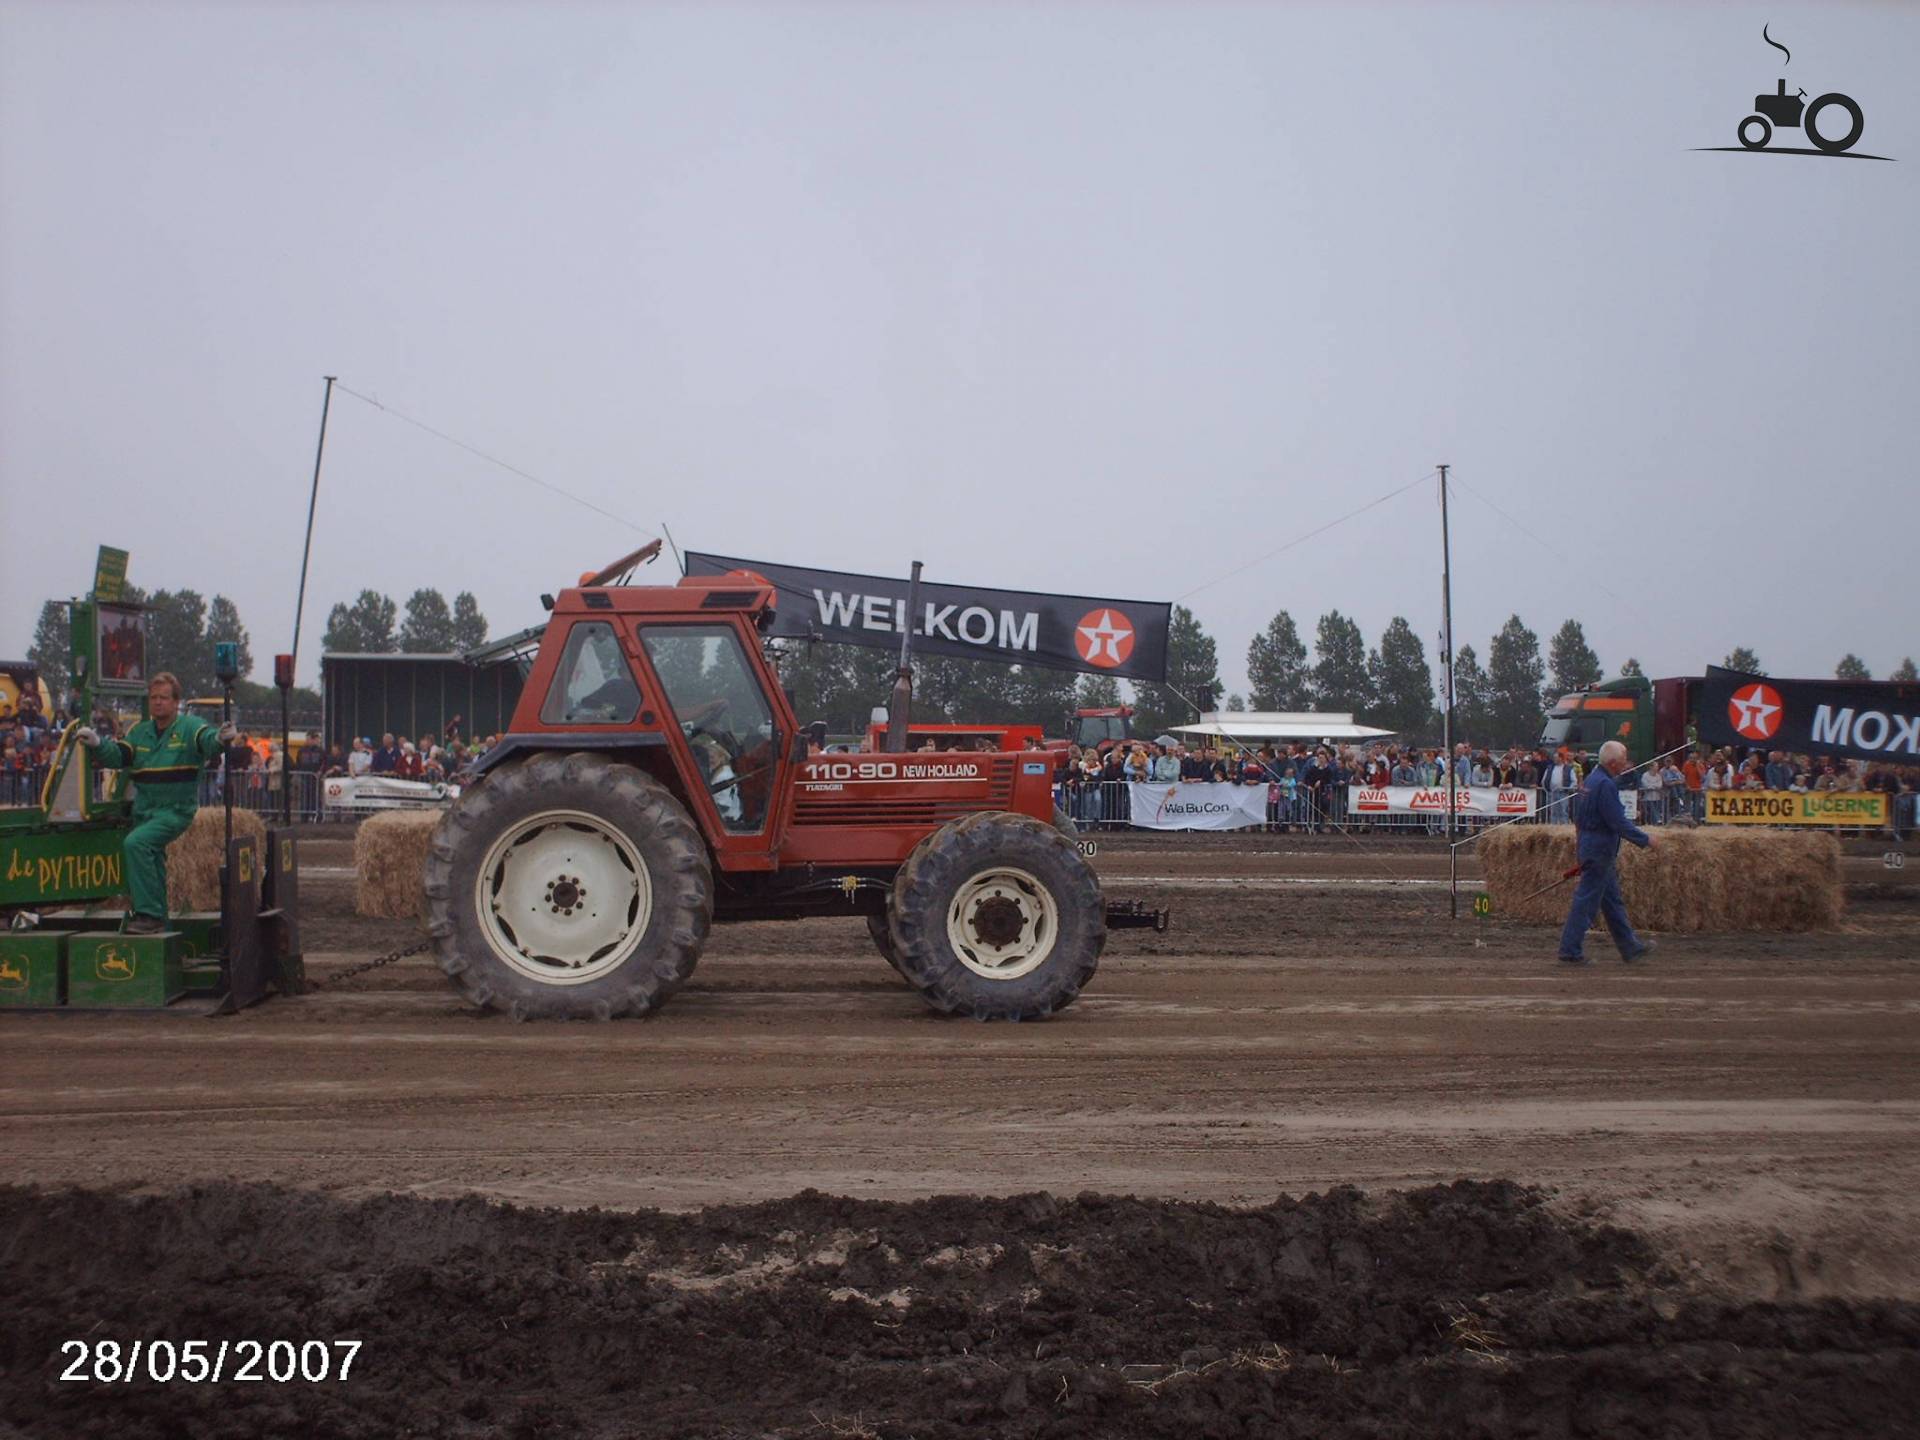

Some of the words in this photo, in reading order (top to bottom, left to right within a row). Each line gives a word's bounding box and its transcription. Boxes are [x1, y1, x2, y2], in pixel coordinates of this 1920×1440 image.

[813, 588, 1040, 652] WELKOM
[805, 762, 897, 779] 110-90
[903, 764, 926, 778] NEW
[927, 764, 978, 777] HOLLAND
[1358, 790, 1388, 801] AVIA
[1409, 791, 1471, 808] MARES
[1711, 798, 1795, 817] HARTOG
[1802, 798, 1880, 818] LUCERNE
[1076, 841, 1095, 856] 30
[38, 852, 120, 894] PYTHON
[1474, 896, 1489, 913] 40
